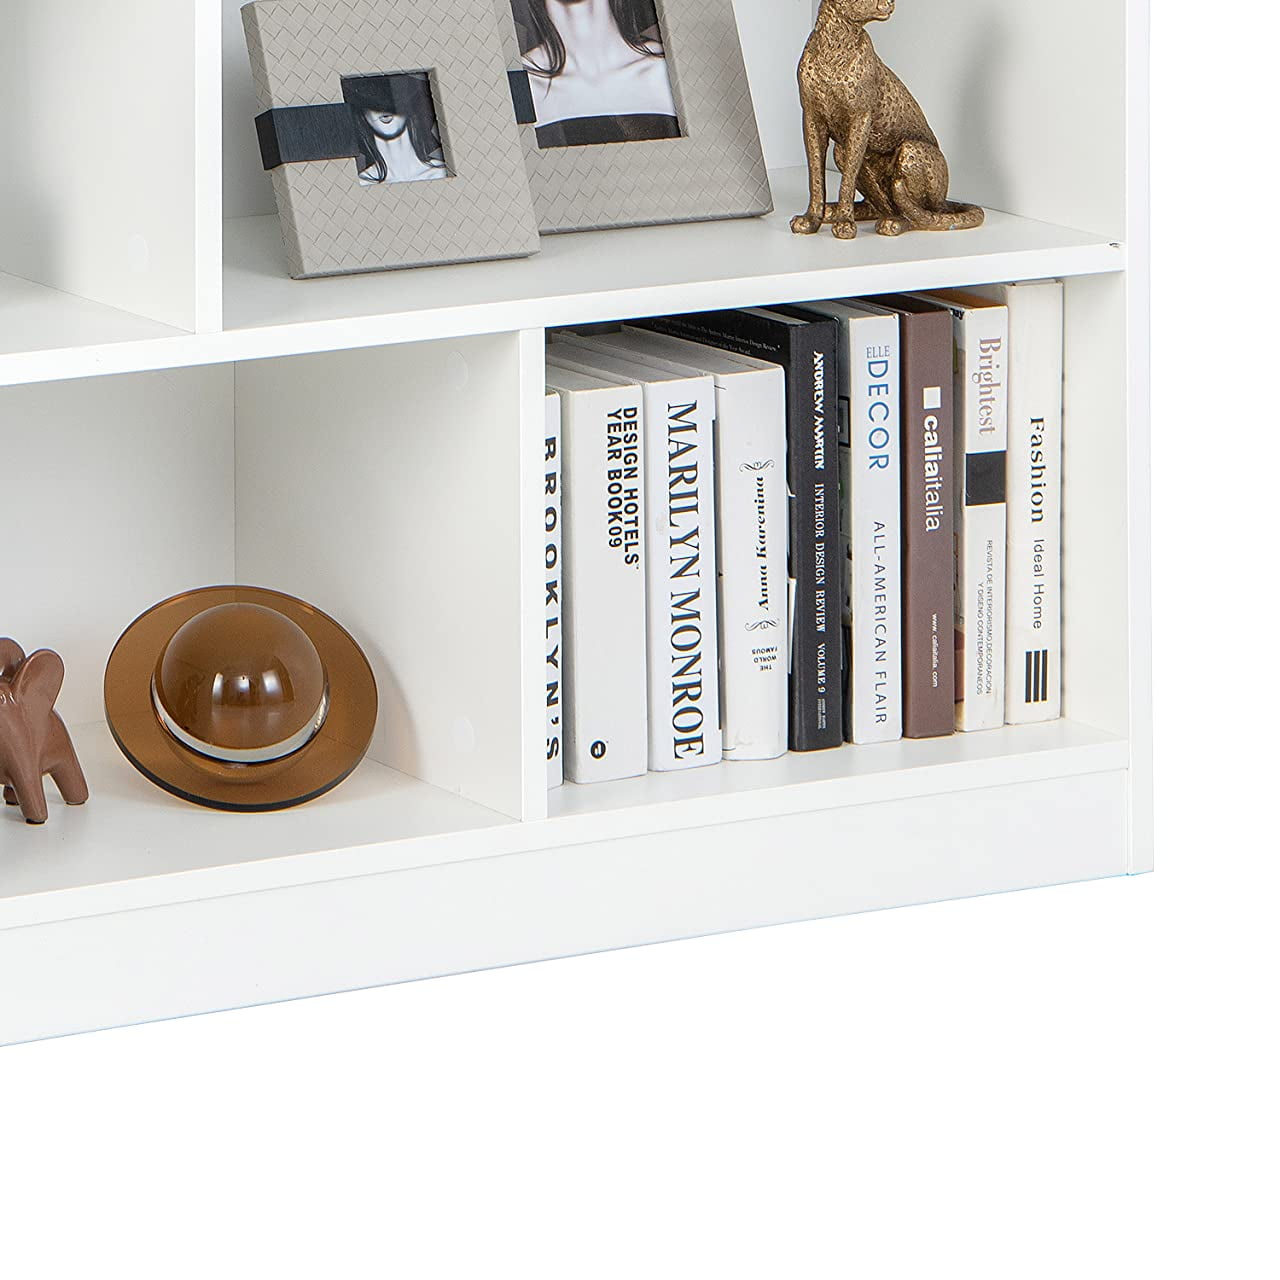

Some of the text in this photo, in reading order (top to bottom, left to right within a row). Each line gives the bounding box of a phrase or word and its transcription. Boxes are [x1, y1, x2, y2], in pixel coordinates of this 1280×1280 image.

[866, 345, 890, 359] ELLE
[971, 336, 1002, 436] Brightest
[607, 407, 623, 461] YEAR
[868, 359, 890, 470] DECOR
[623, 406, 640, 566] DESIGN HOTELS
[814, 483, 825, 539] INTERIOR
[923, 414, 943, 532] caliaitalia
[1030, 417, 1047, 523] Fashion
[667, 400, 705, 760] MARILYN MONROE
[754, 476, 769, 610] Anna Karenina
[815, 543, 826, 585] DESIGN
[1032, 538, 1045, 630] Ideal Home
[751, 646, 777, 655] FAMOUS
[815, 590, 826, 633] REVIEW
[873, 521, 887, 724] ALL-AMERICAN FLAIR
[817, 643, 826, 684] VOLUME
